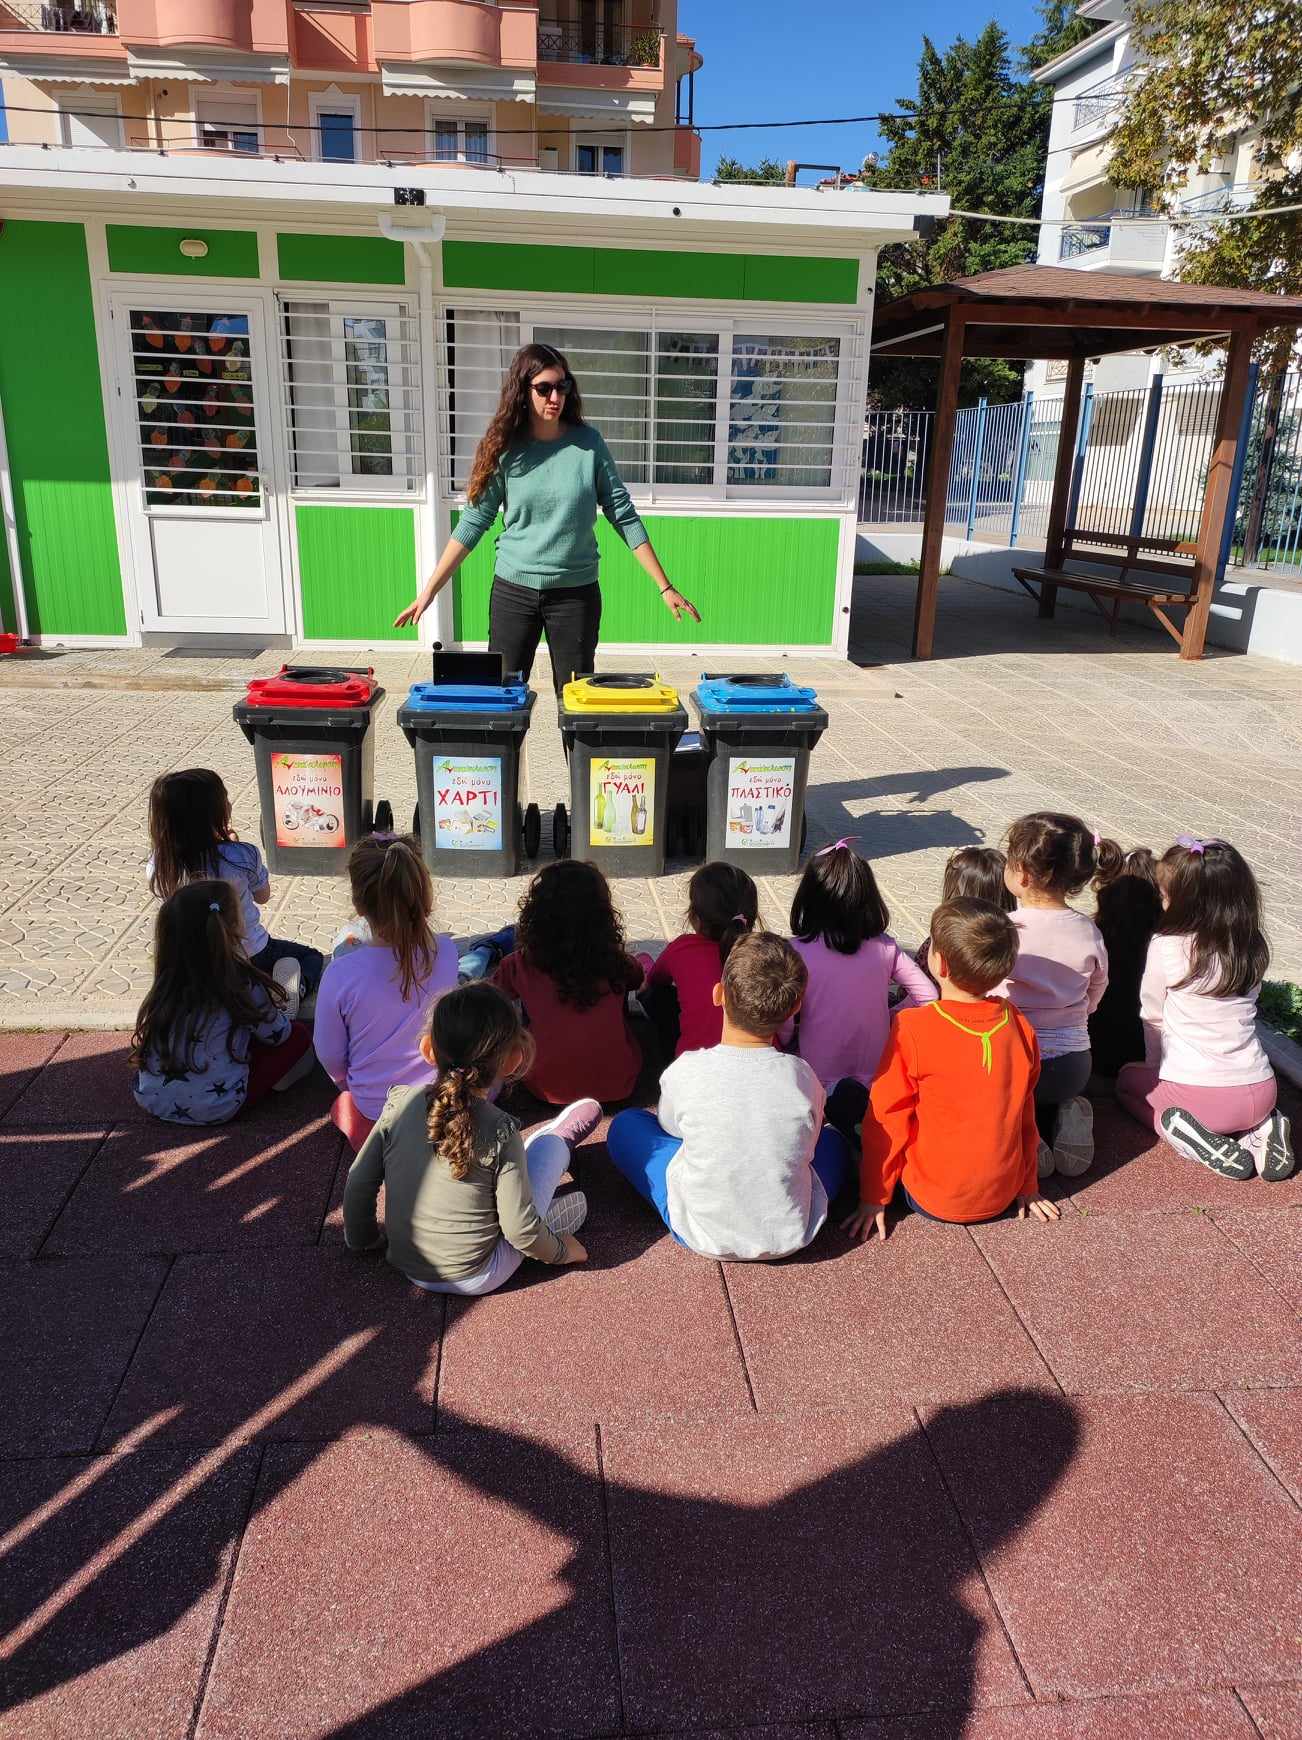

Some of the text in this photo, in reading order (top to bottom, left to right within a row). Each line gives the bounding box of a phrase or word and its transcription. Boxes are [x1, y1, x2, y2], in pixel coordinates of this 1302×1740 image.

[276, 784, 341, 797] ΑΛΟΥΜΙΝΙΟ
[603, 781, 645, 795] ΓΥΑΛΙ
[437, 788, 497, 806] ΧΑΡΤΙ
